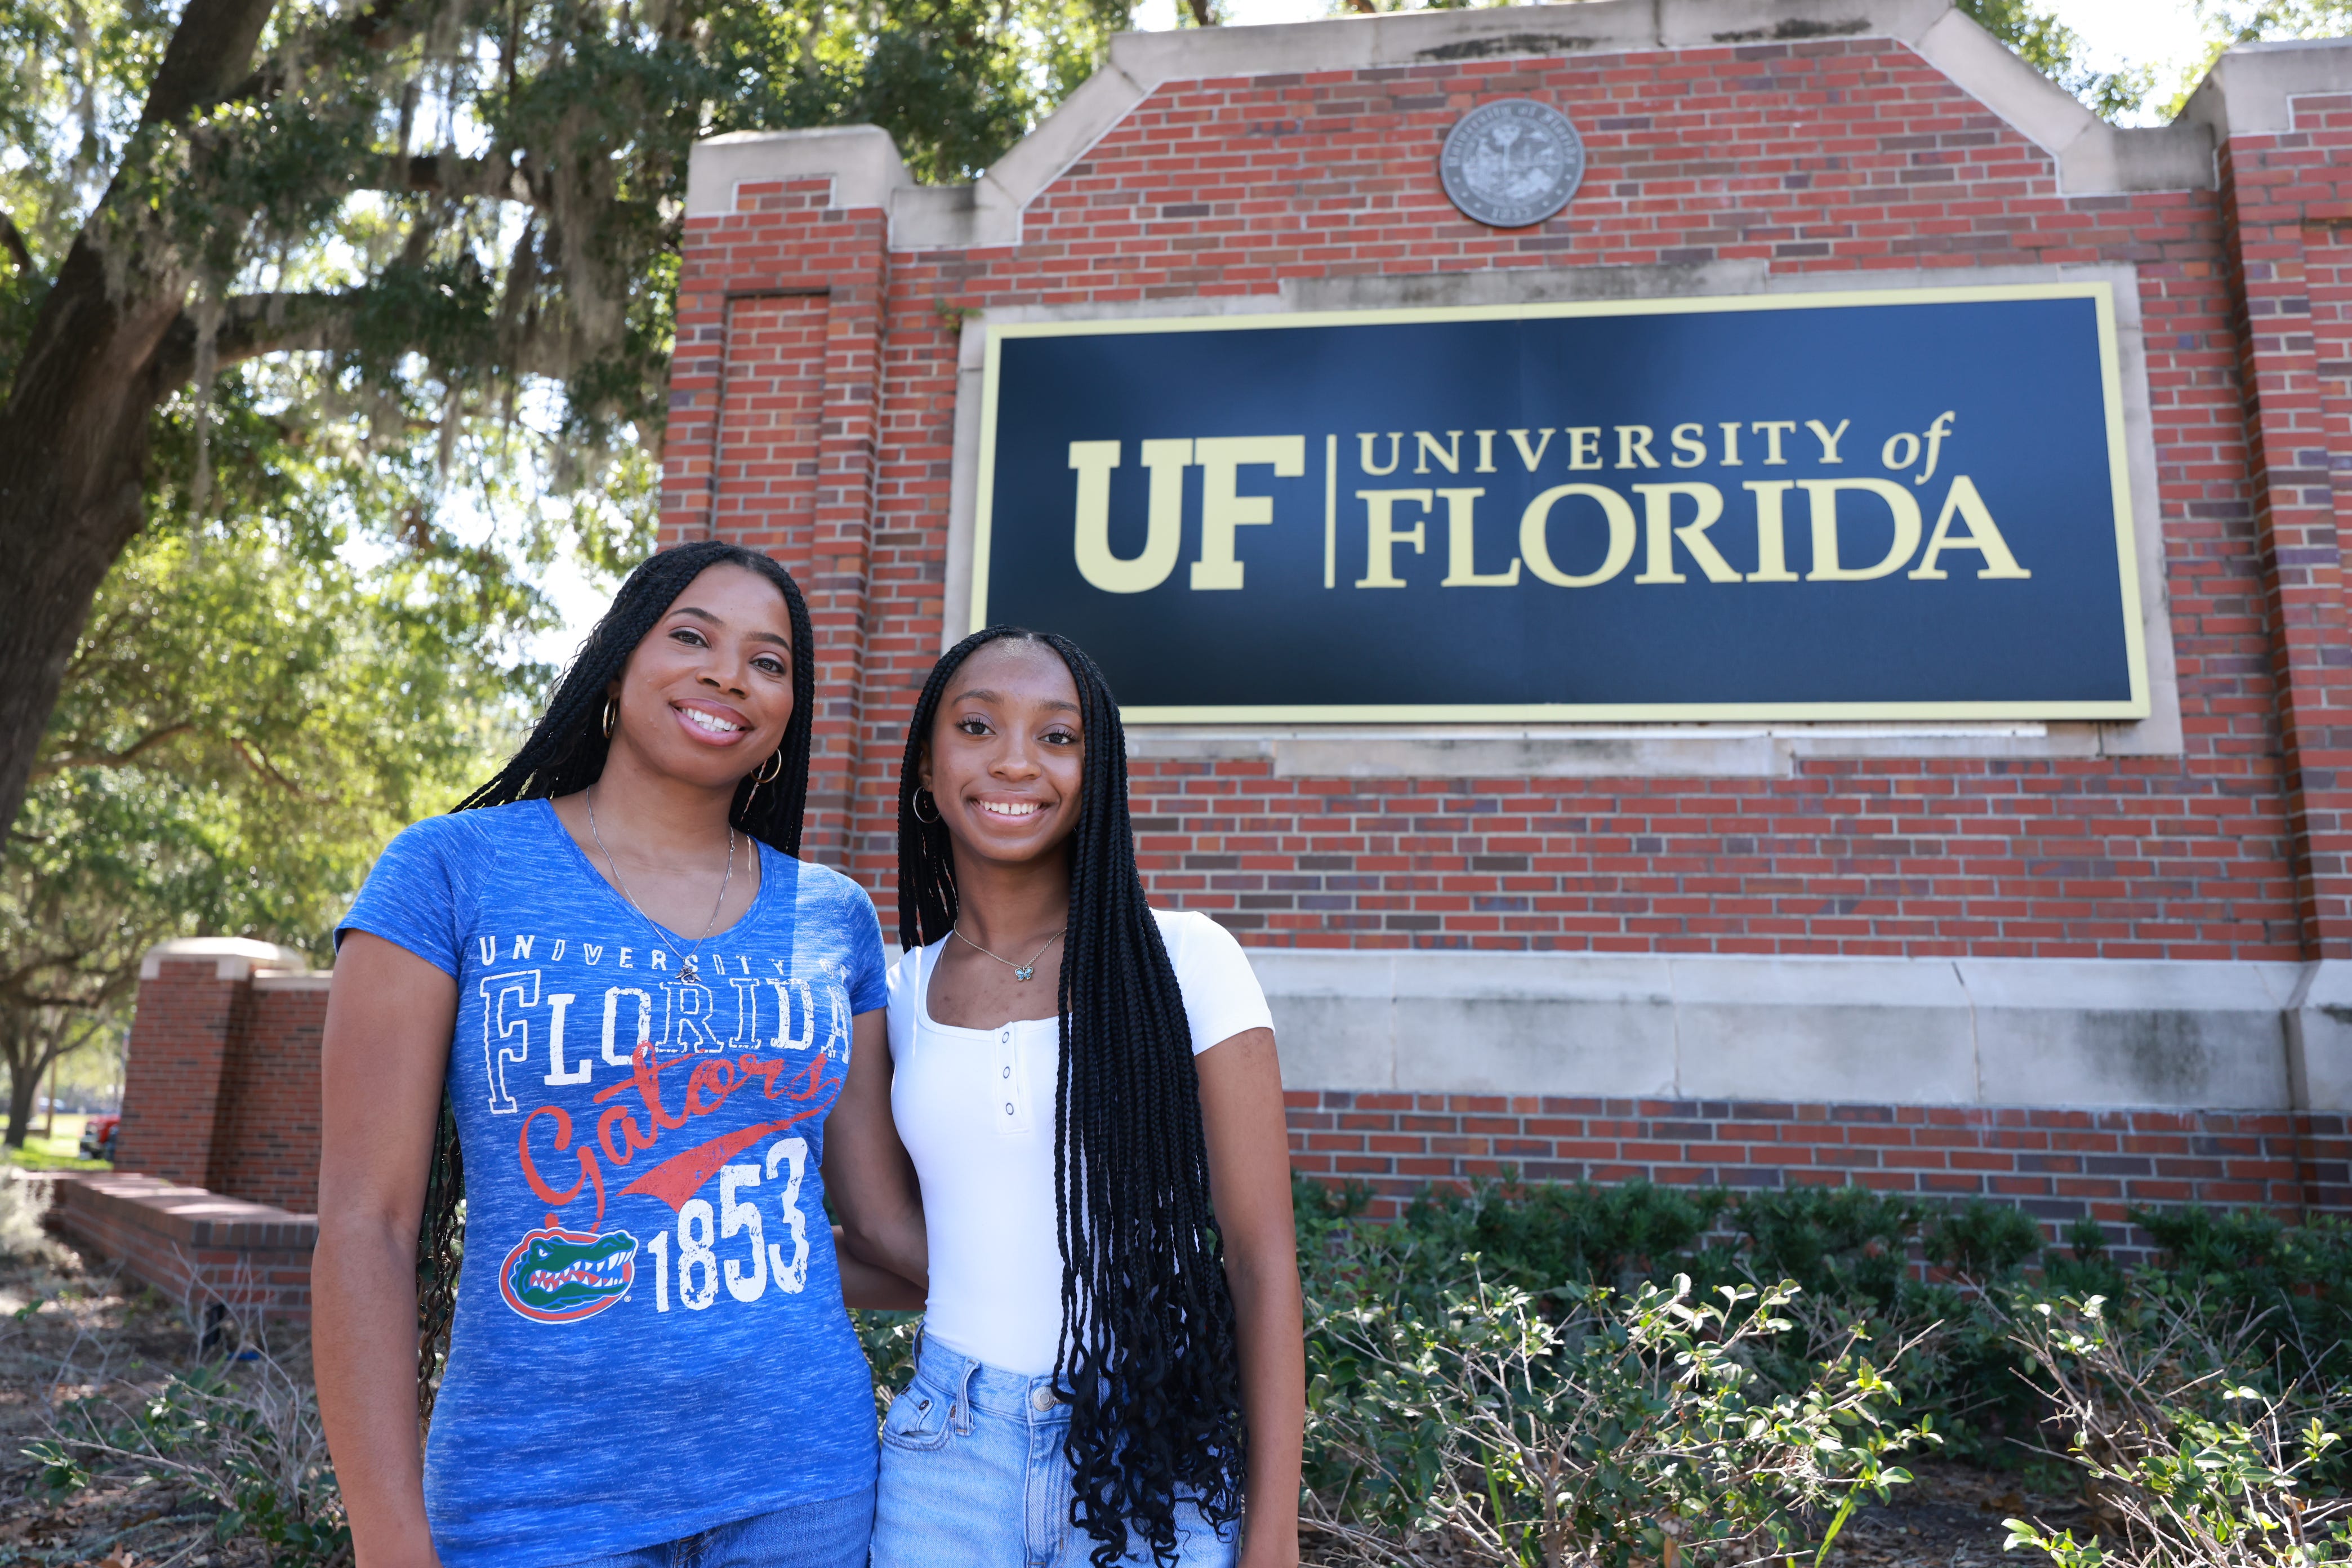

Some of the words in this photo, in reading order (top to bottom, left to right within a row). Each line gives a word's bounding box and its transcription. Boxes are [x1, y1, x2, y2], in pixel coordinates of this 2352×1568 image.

[1068, 434, 1306, 594] UF
[1357, 418, 1850, 476] UNIVERSITY
[1881, 410, 1955, 485] of
[1355, 474, 2032, 589] FLORIDA
[479, 969, 850, 1115] FLORIDA
[518, 1040, 828, 1233] Gators
[647, 1137, 810, 1313] 1853
